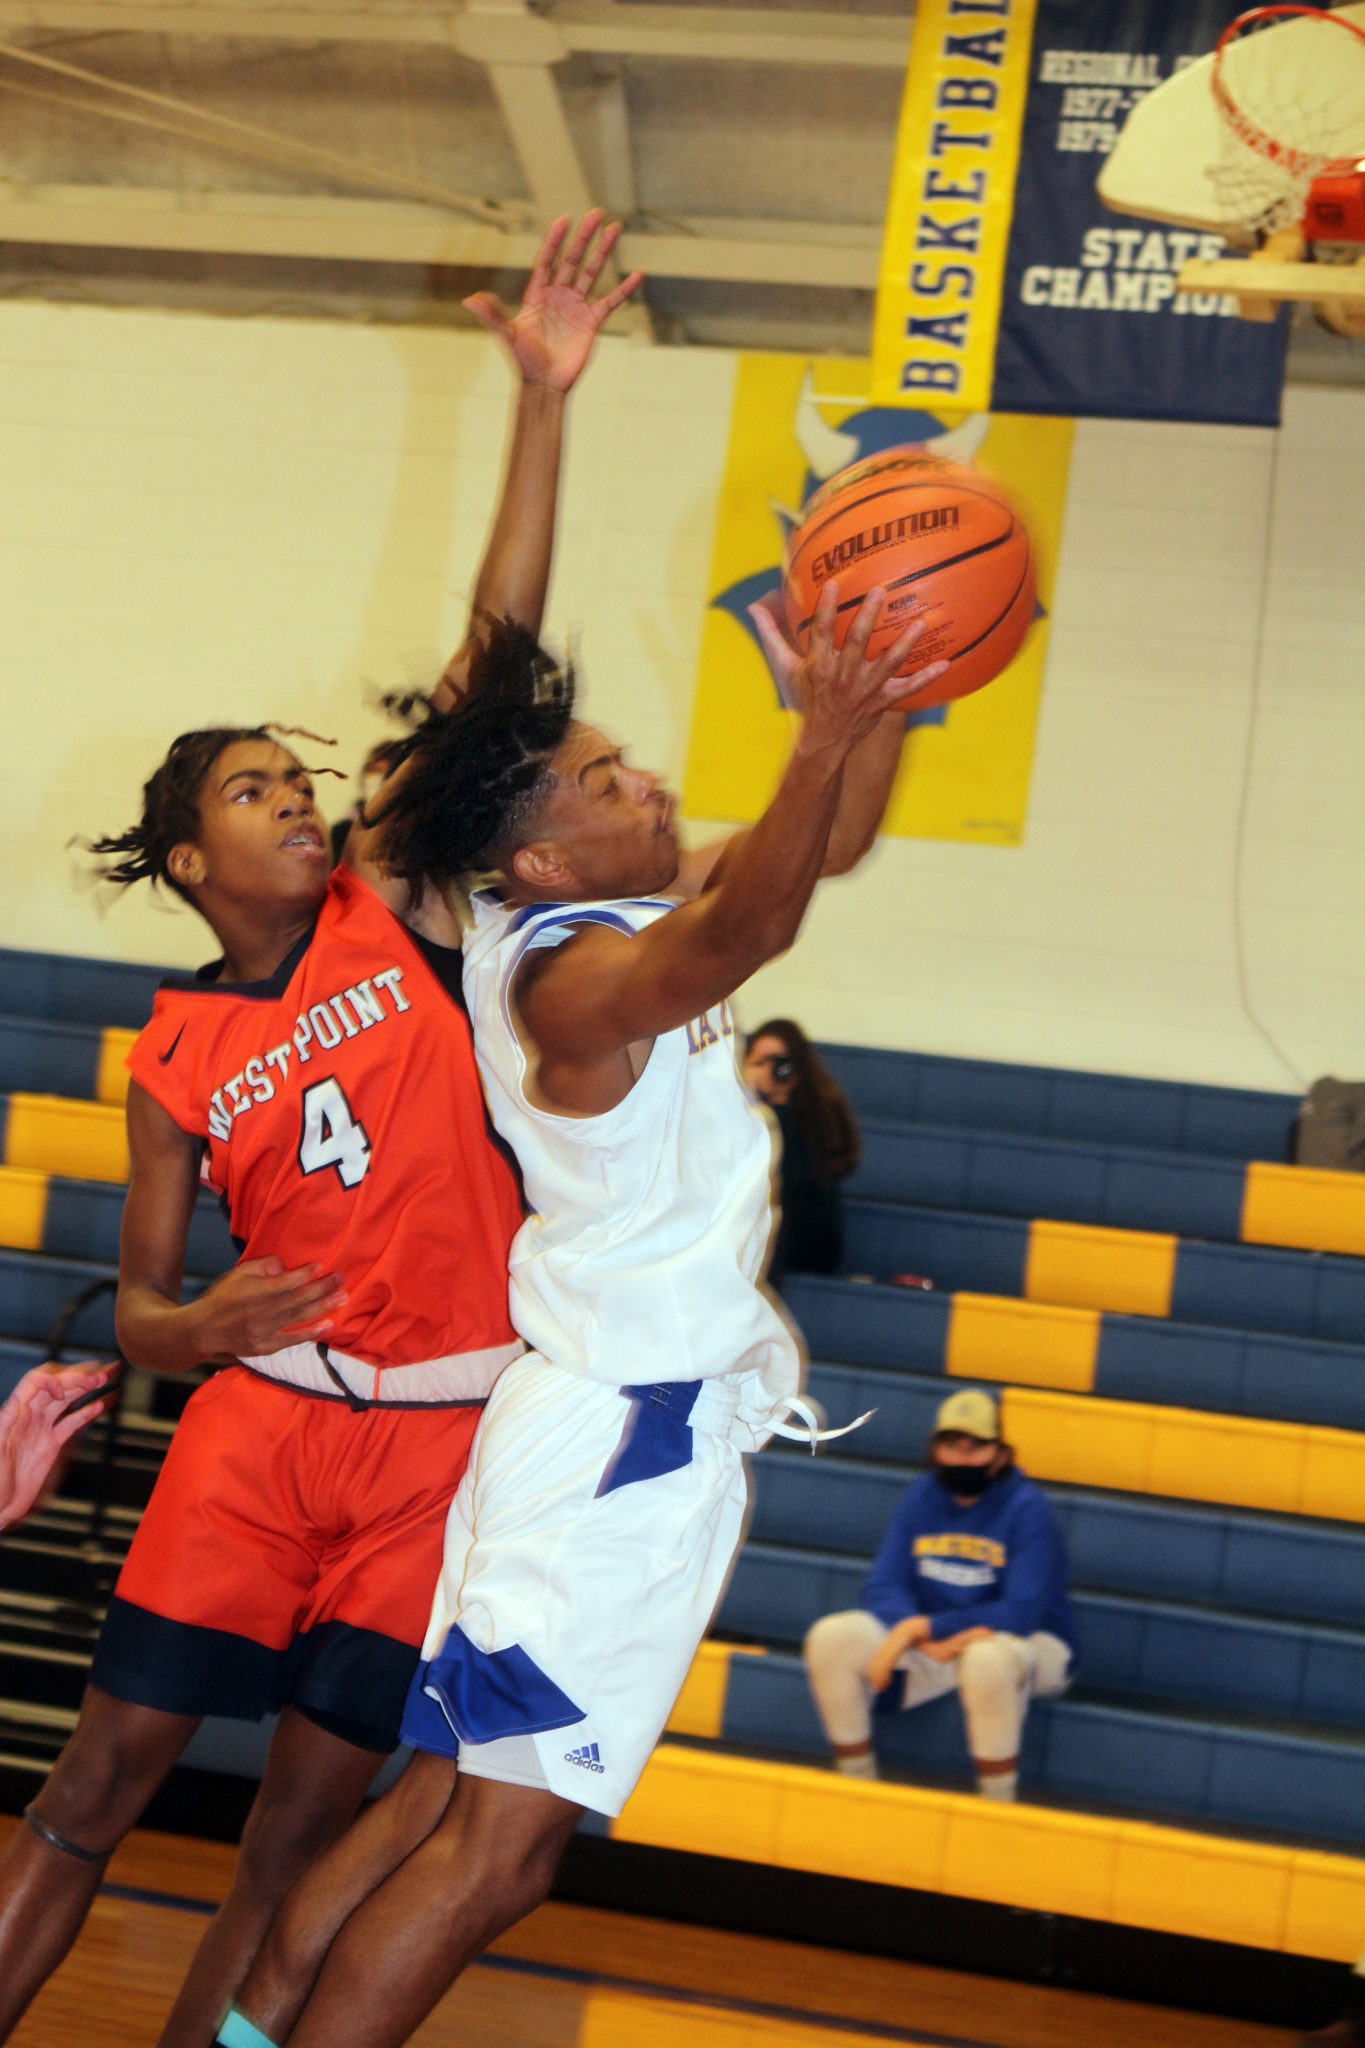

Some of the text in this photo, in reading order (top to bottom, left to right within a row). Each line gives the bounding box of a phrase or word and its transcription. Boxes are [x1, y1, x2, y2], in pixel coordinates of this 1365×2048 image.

[1061, 88, 1150, 118] 1977-
[811, 506, 959, 582] EVOLUTION
[207, 965, 411, 1142] WEST POINT
[298, 1074, 372, 1192] 4
[564, 1753, 605, 1773] adidas
